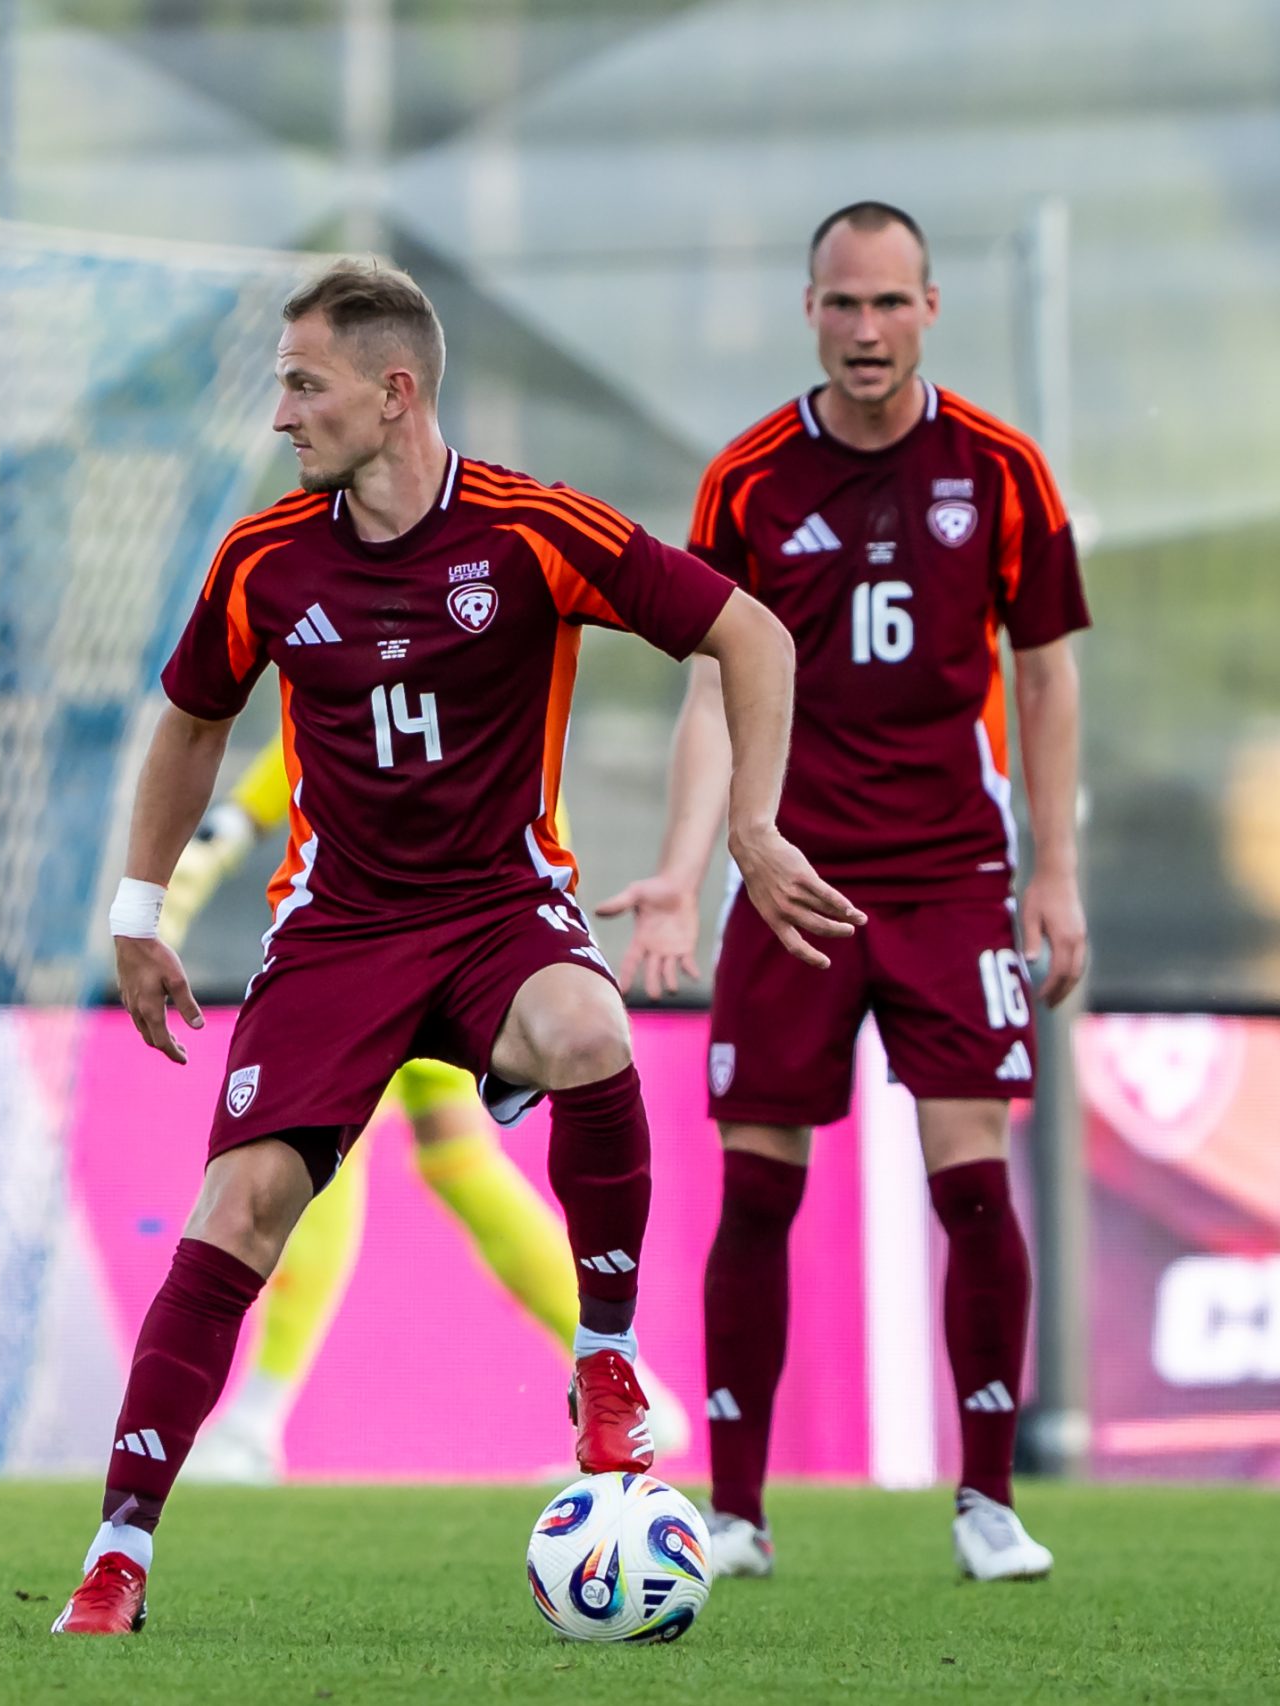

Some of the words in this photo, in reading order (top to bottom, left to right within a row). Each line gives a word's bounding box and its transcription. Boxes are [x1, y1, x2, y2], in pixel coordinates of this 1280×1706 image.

[852, 580, 914, 665] 16
[371, 682, 443, 768] 14
[978, 948, 1030, 1029] 16
